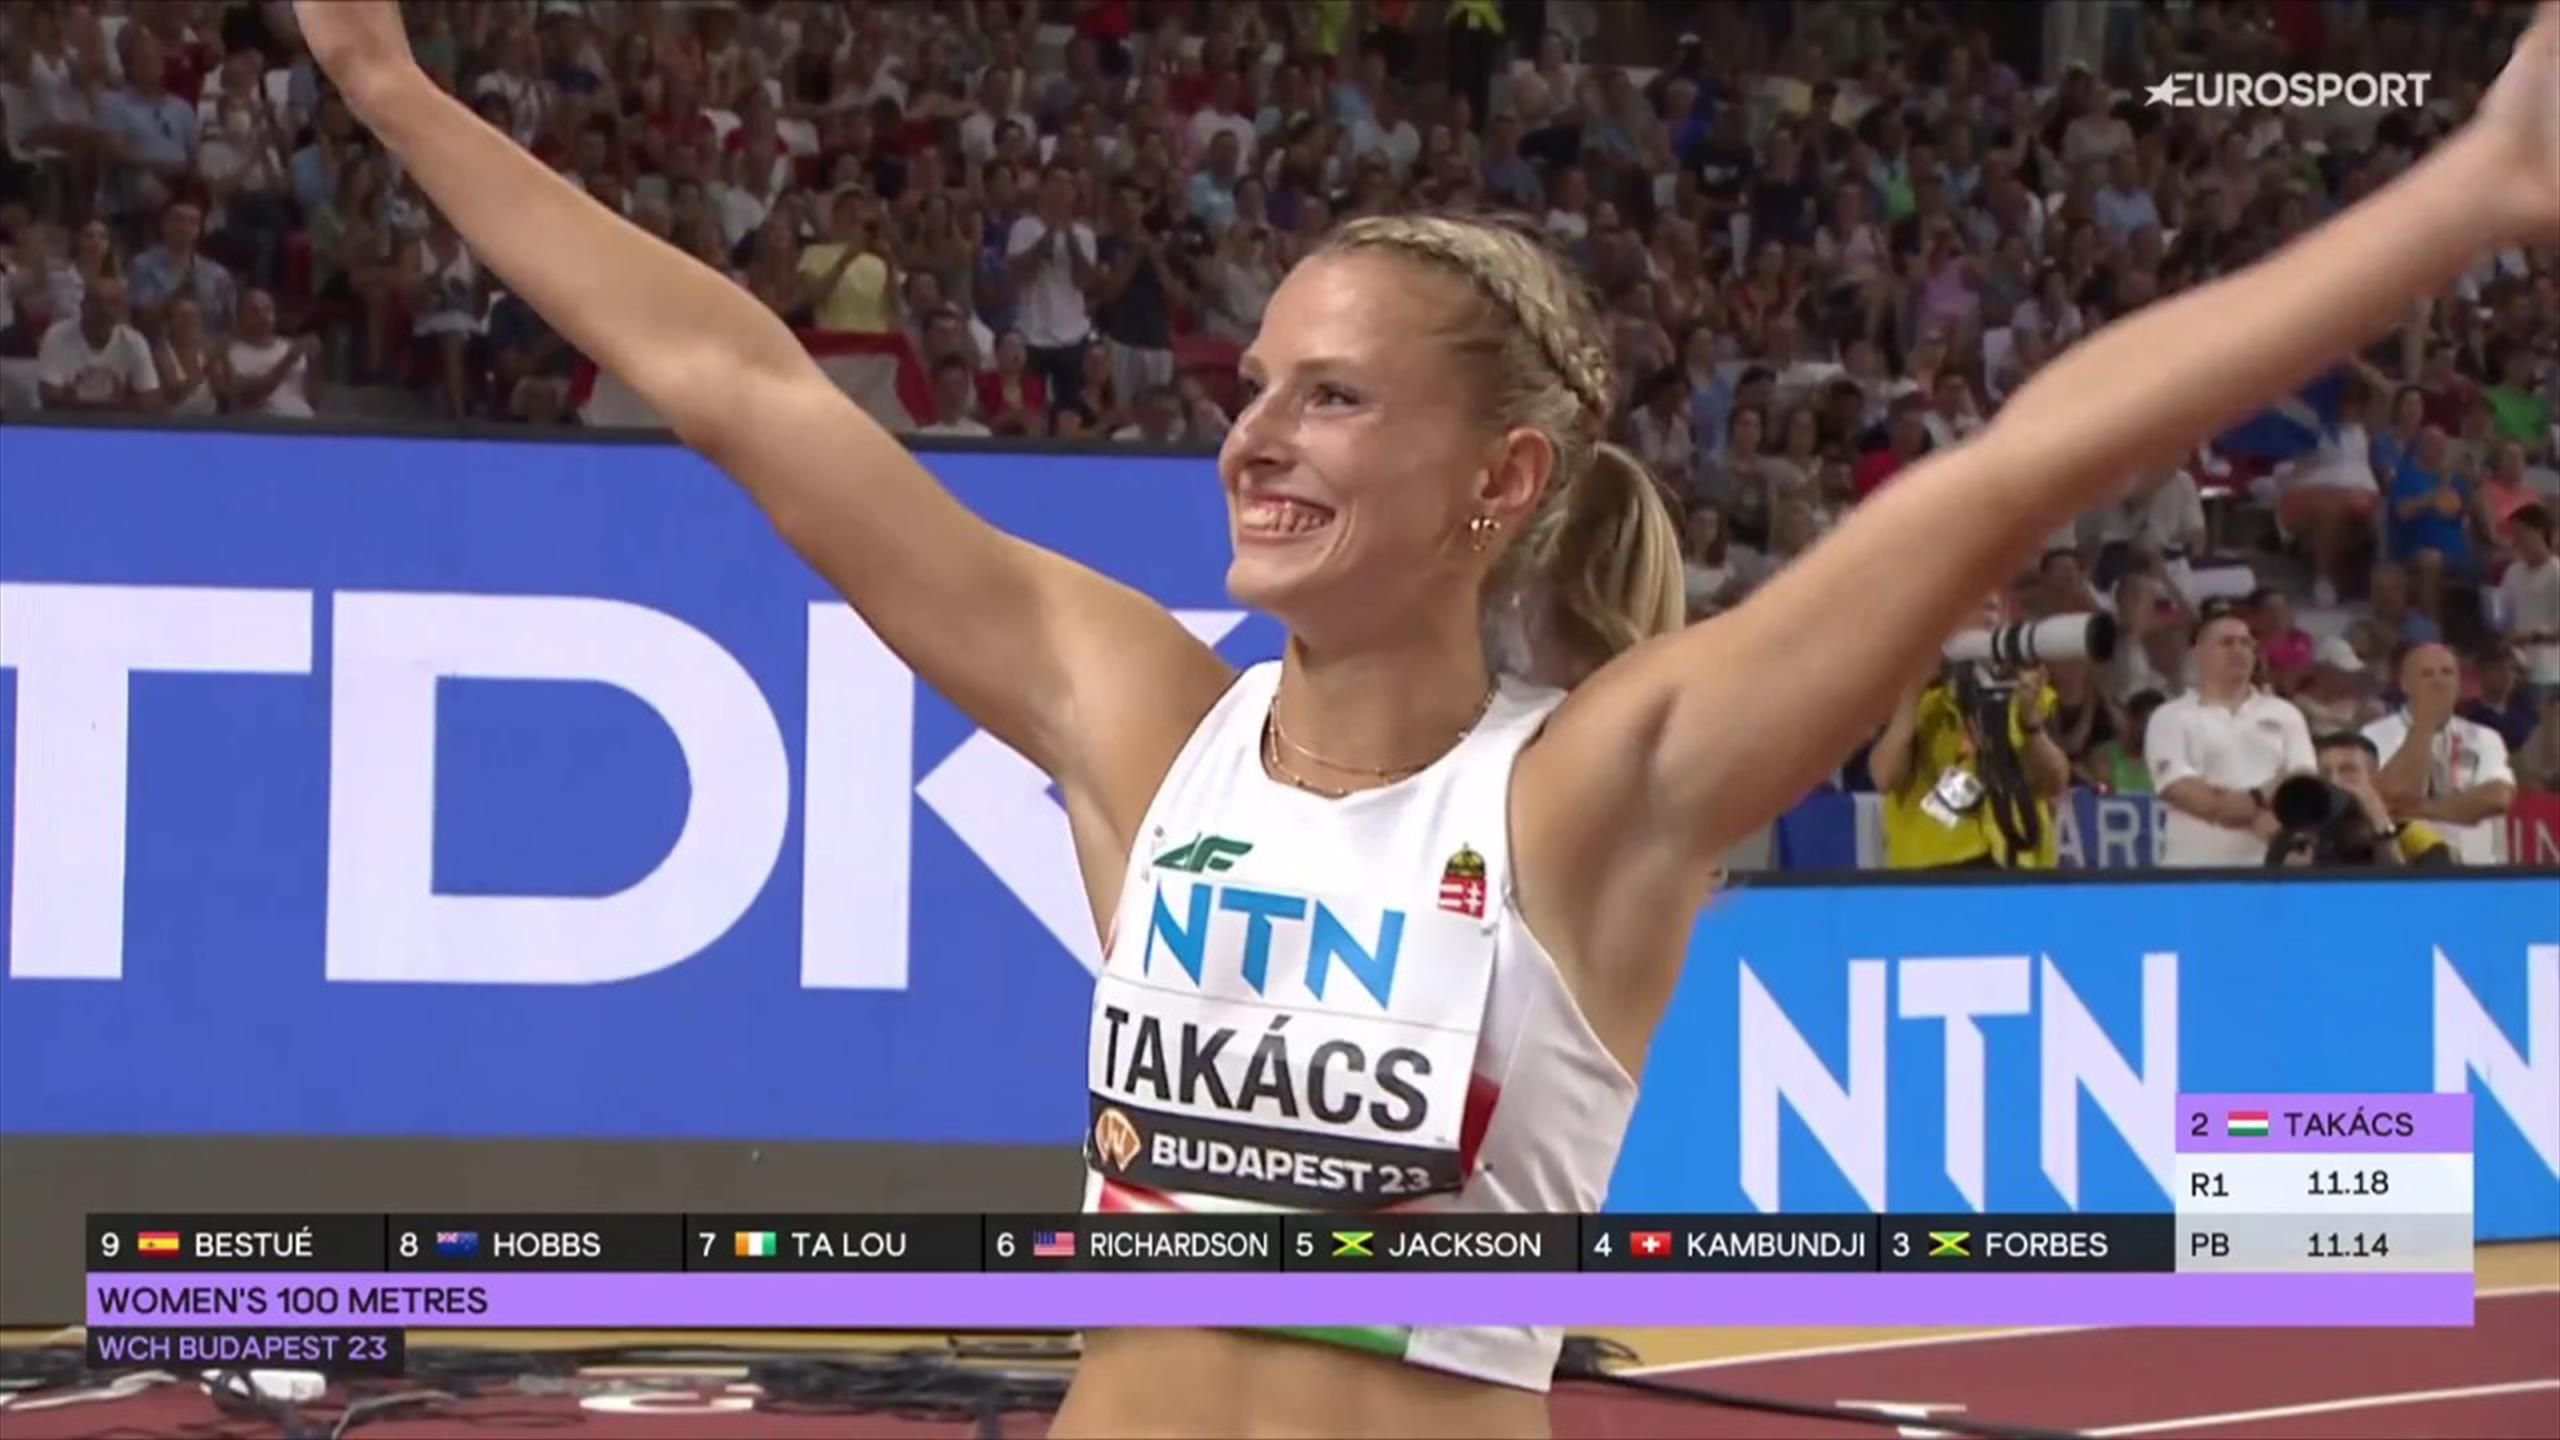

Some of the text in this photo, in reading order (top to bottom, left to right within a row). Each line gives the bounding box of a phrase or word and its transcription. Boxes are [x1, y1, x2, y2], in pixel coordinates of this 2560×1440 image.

[0, 581, 1247, 991] TDK
[1143, 878, 1406, 1011] NTN
[1104, 1006, 1433, 1133] TAKÁCS
[1739, 950, 2179, 1213] NTN
[1151, 1133, 1432, 1193] BUDAPEST 23
